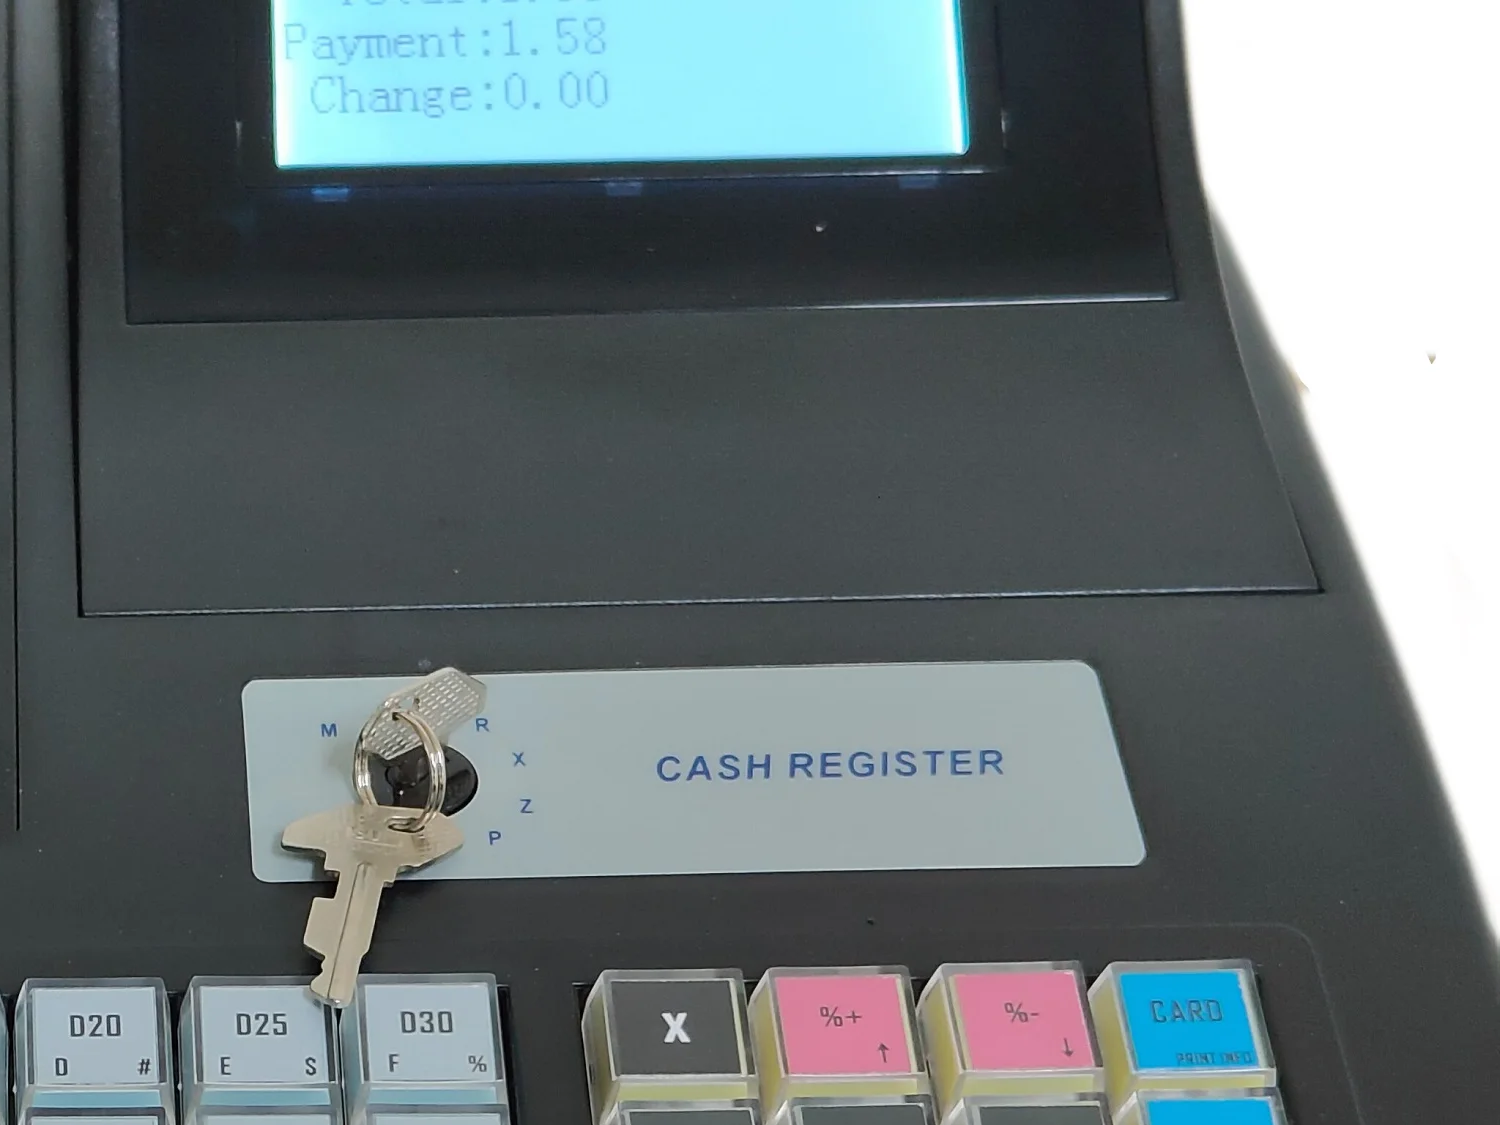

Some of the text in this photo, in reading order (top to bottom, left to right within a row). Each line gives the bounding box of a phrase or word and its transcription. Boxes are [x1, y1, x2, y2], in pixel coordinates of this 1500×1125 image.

[321, 723, 337, 737] M
[476, 718, 489, 731] R
[513, 752, 525, 766] X
[657, 750, 1003, 781] CASH REGISTER
[520, 799, 533, 813] Z
[489, 831, 501, 845] P
[1152, 1000, 1222, 1023] CARD
[70, 1015, 121, 1037] D20
[237, 1014, 287, 1035] D25
[401, 1011, 453, 1033] D30
[662, 1013, 690, 1042] X
[139, 1059, 150, 1074] #
[221, 1057, 231, 1075] E
[389, 1054, 398, 1072] F
[469, 1056, 487, 1072] %
